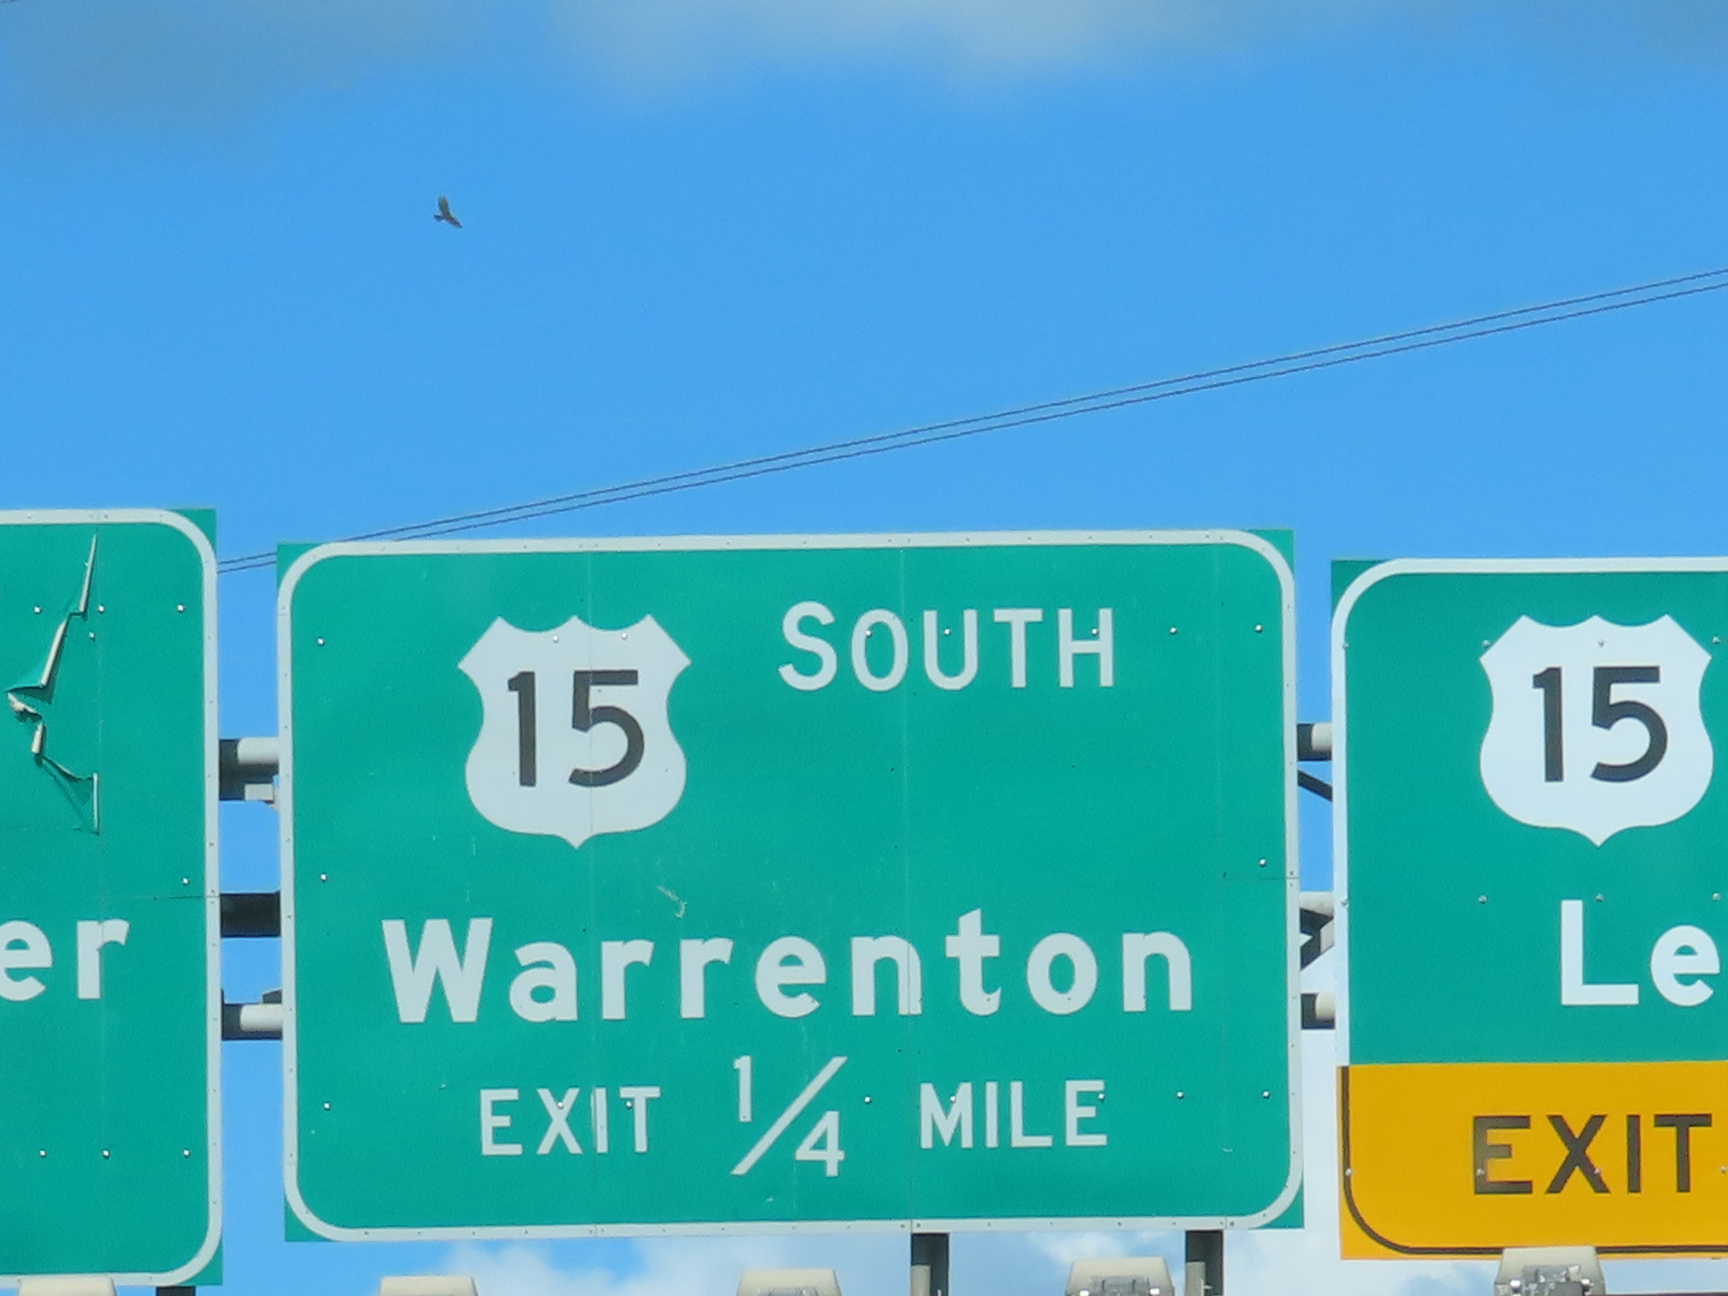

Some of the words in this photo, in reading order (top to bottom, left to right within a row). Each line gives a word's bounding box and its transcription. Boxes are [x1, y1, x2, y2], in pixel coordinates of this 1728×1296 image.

[777, 600, 1115, 692] SOUTH
[505, 668, 646, 788] 15
[1530, 665, 1670, 784] 15
[381, 907, 1193, 1025] Warrenton
[479, 1085, 663, 1157] EXIT
[919, 1079, 1109, 1149] MILE
[1472, 1112, 1713, 1196] EXIT
